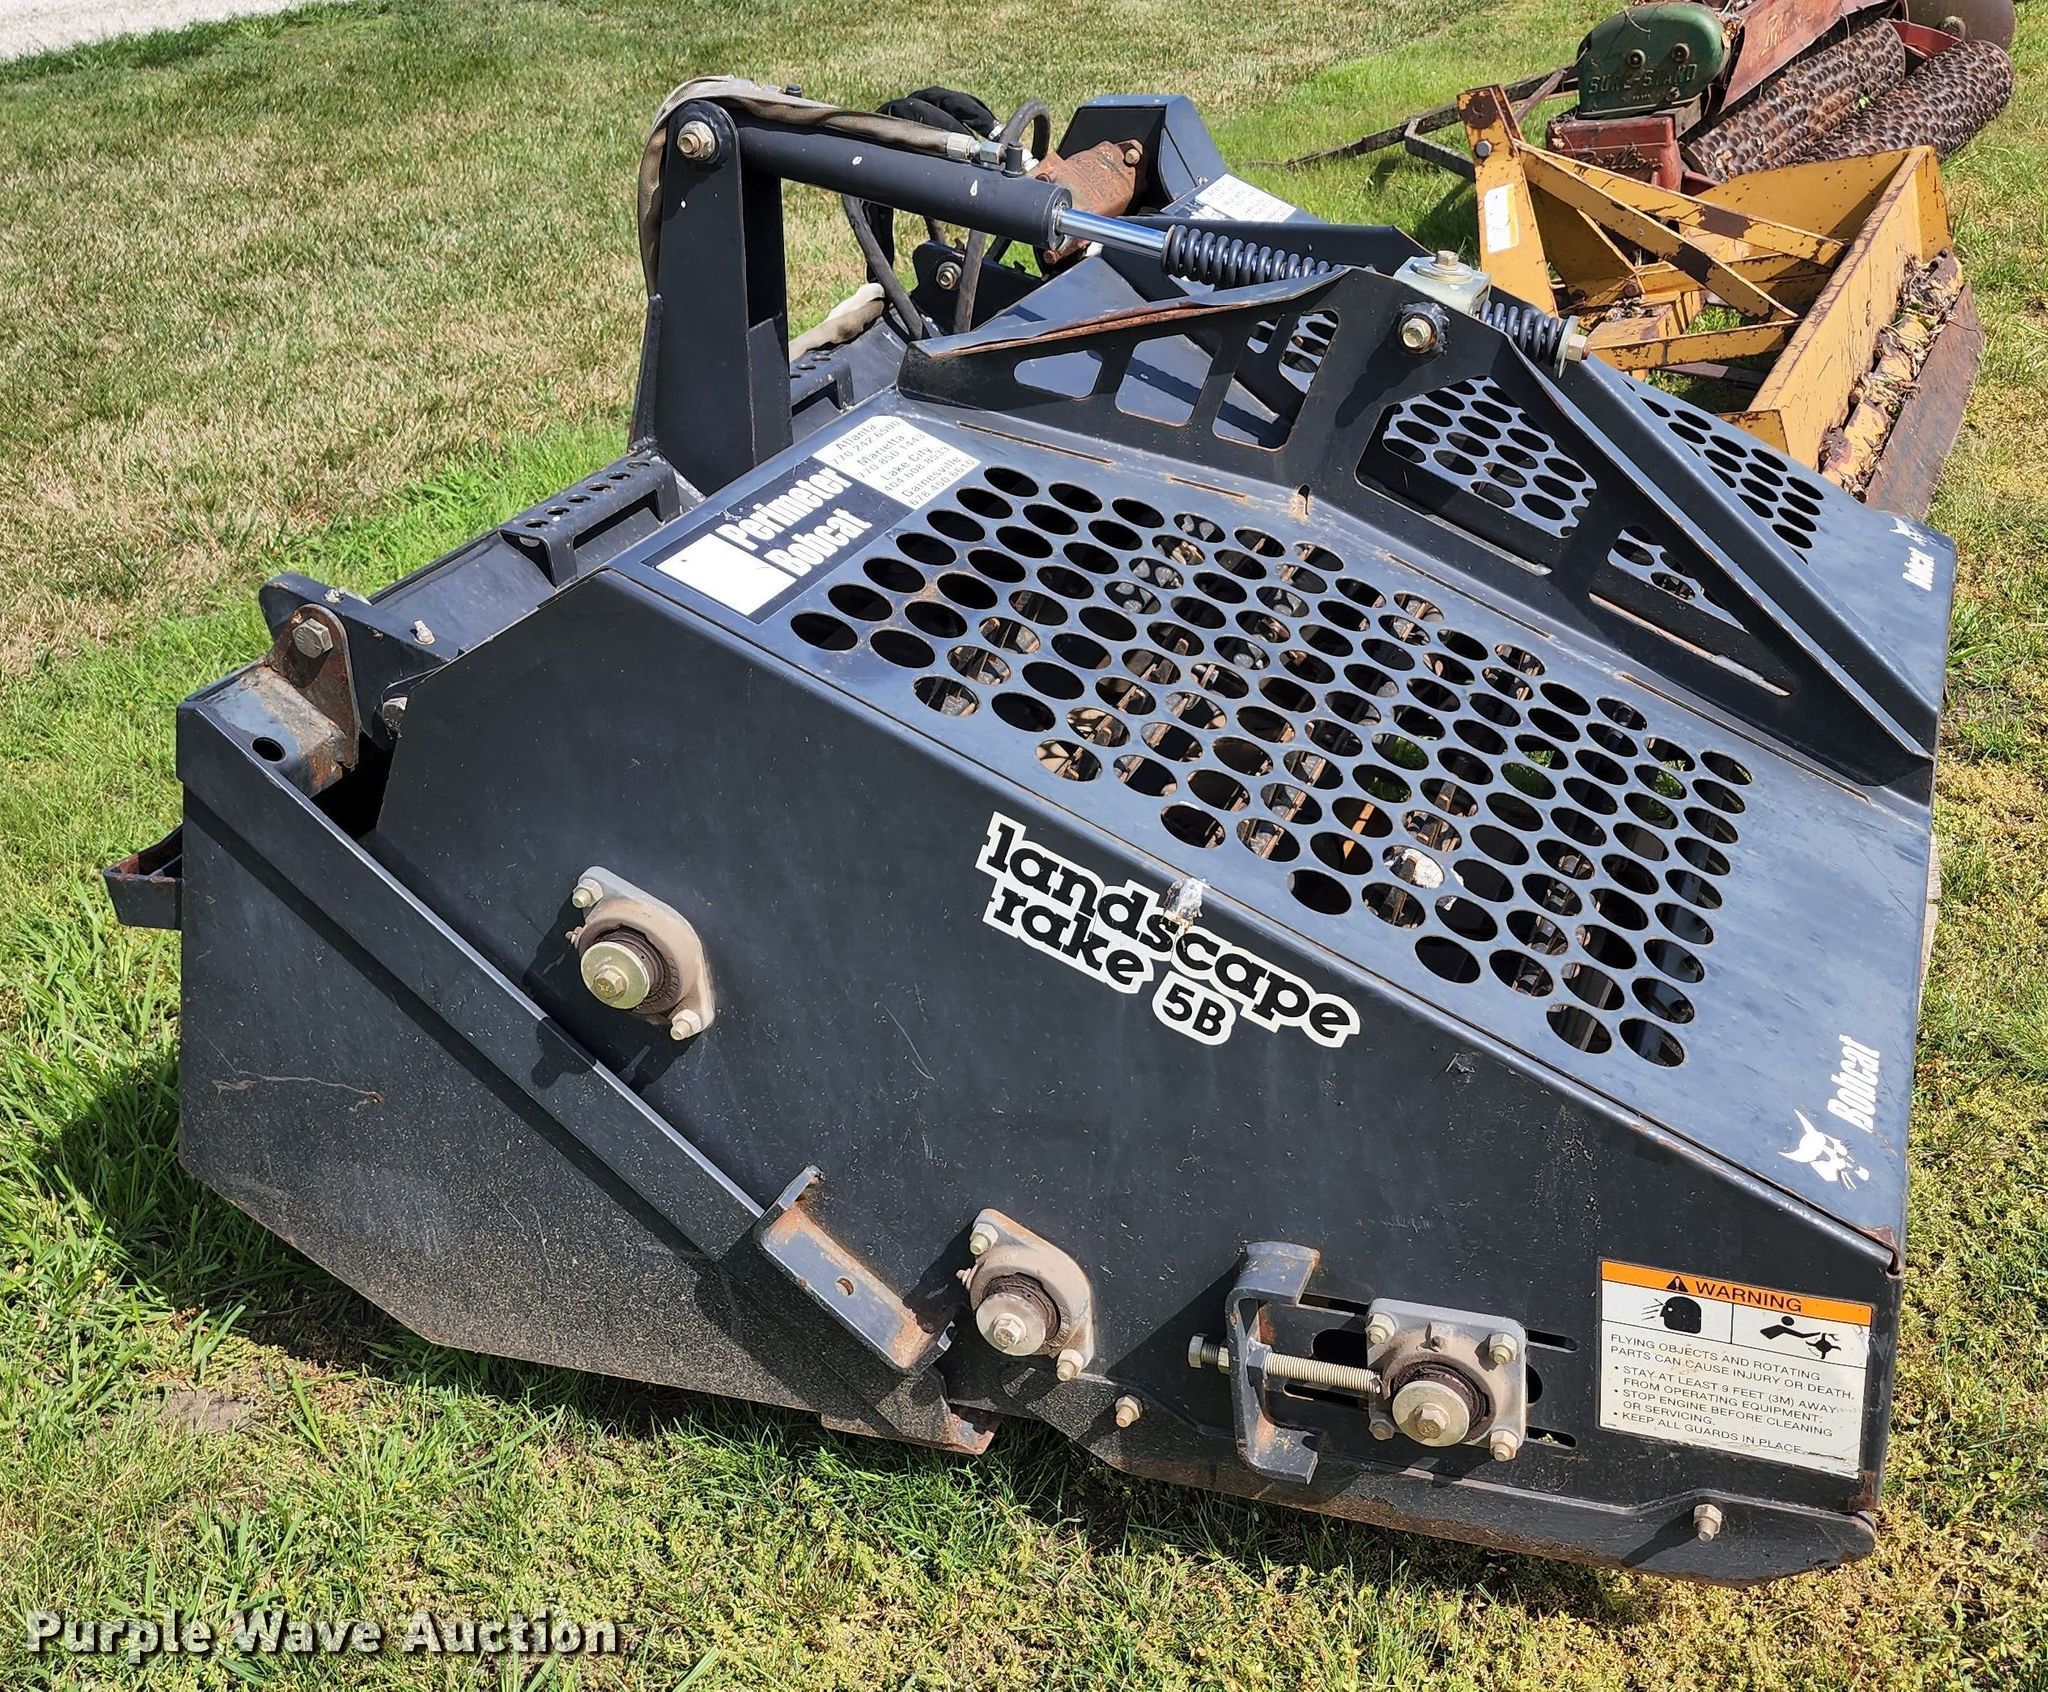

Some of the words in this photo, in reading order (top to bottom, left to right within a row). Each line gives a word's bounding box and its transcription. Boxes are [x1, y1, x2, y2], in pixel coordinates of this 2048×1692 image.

[836, 425, 876, 450] Atlanta
[857, 436, 904, 466] Marietta
[880, 462, 910, 480] Lake
[908, 447, 933, 462] City
[902, 456, 961, 497] Gainesville
[715, 467, 853, 550] Perimeter
[764, 508, 873, 577] Bobcat
[1903, 546, 1935, 592] Bobcat
[986, 822, 1352, 1039] landscape
[993, 886, 1146, 986] rake
[1161, 984, 1227, 1038] 5B
[1827, 1034, 1880, 1133] Bobcat
[1695, 1281, 1802, 1312] WARNING
[1611, 1334, 1654, 1349] FLYING
[1659, 1343, 1718, 1361] OBJECTS
[1722, 1355, 1749, 1367] AND
[1753, 1361, 1820, 1380] ROTATING
[1611, 1346, 1651, 1360] PARTS
[1655, 1354, 1681, 1366] CAN
[1685, 1360, 1729, 1375] CAUSE
[1733, 1369, 1780, 1385] INJURY
[1784, 1379, 1803, 1390] OR
[1807, 1384, 1855, 1400] DEATH.
[1623, 1365, 1655, 1378] STAY
[1659, 1373, 1675, 1382] AT
[1679, 1376, 1718, 1391] LEAST
[1733, 1386, 1765, 1400] FEET
[1768, 1393, 1795, 1407] (3M)
[1798, 1400, 1837, 1414] AWAY
[1623, 1377, 1660, 1392] FROM
[1664, 1386, 1738, 1406] OPERATING
[1622, 1412, 1654, 1423] KEEP
[1658, 1419, 1681, 1429] ALL
[1684, 1423, 1738, 1441] GUARDS
[1742, 1435, 1755, 1444] IN
[1623, 1389, 1655, 1401] STOP
[1660, 1396, 1706, 1412] ENGINE
[1711, 1406, 1763, 1423] BEFORE
[1766, 1417, 1833, 1437] CLEANING
[1623, 1400, 1641, 1411] OR
[1645, 1404, 1716, 1426] SERVICING.
